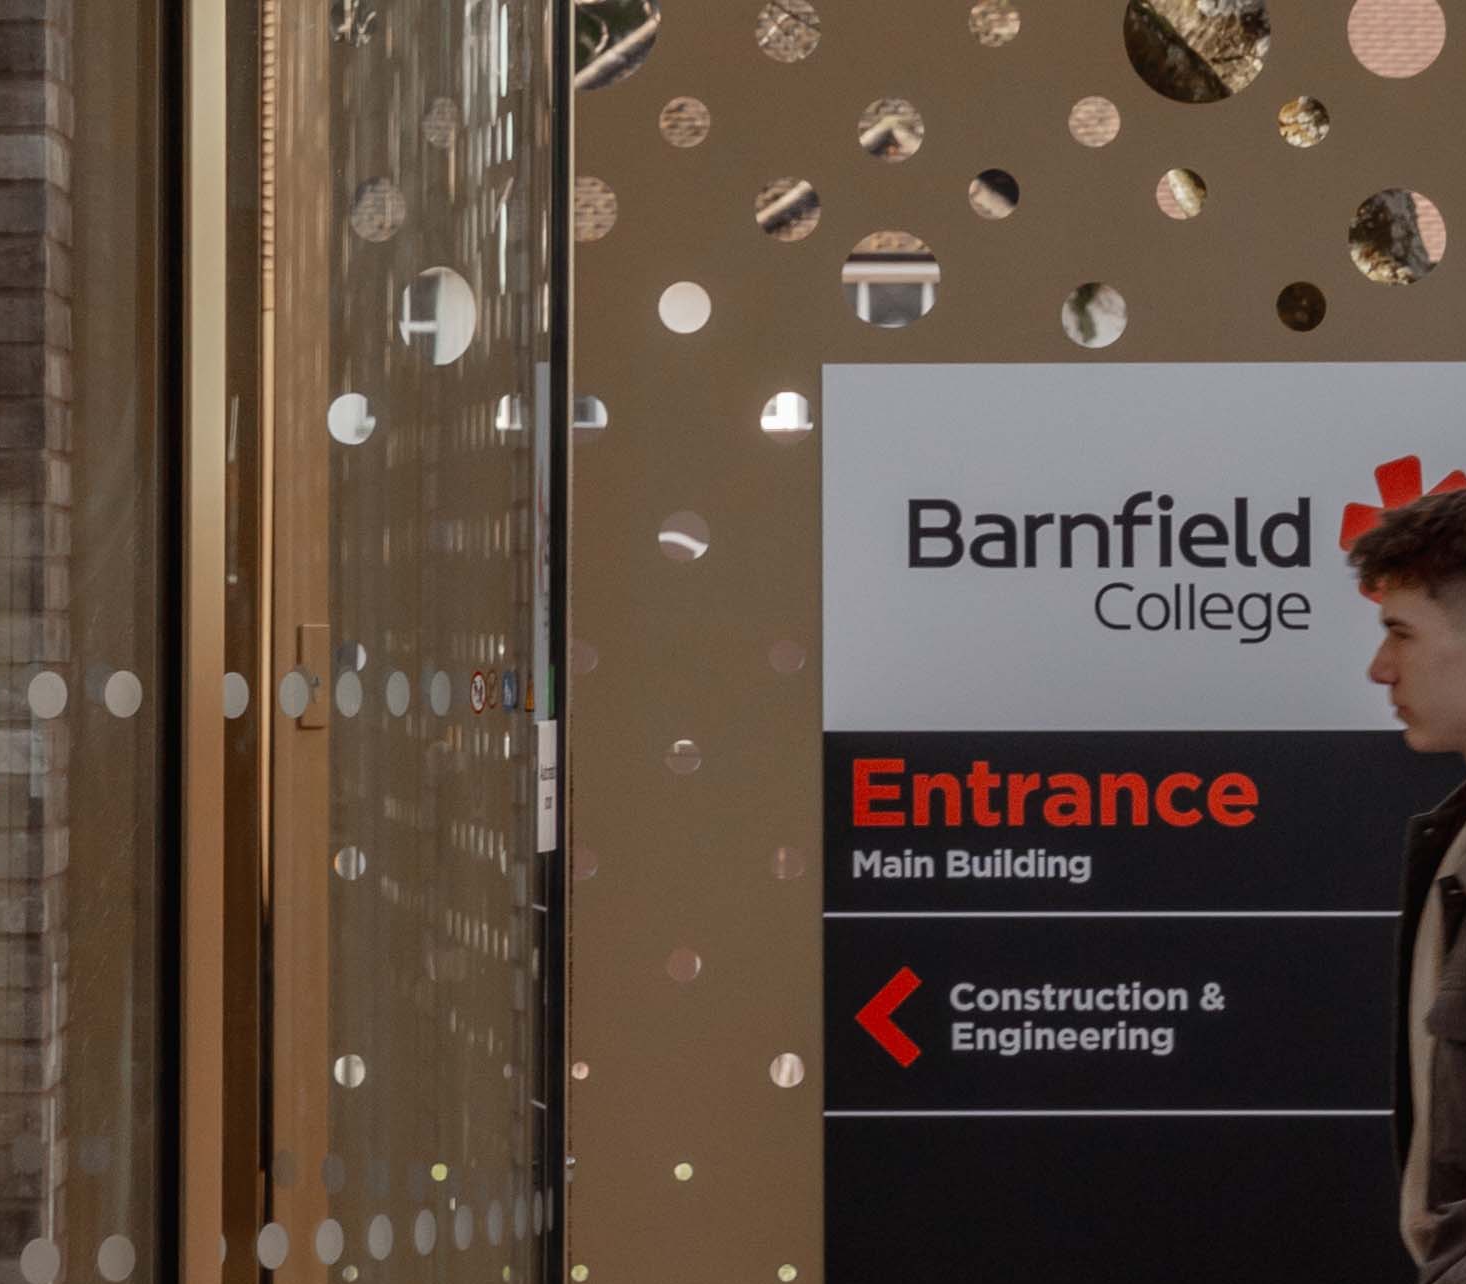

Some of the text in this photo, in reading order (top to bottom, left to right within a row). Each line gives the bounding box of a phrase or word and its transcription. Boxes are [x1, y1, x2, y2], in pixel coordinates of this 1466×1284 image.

[908, 490, 1311, 569] Barnfield
[1094, 582, 1311, 644] College
[853, 757, 1259, 828] Entrance
[853, 848, 1092, 884] Main Building
[949, 981, 1226, 1012] Construction &
[951, 1020, 1175, 1056] Engineering
